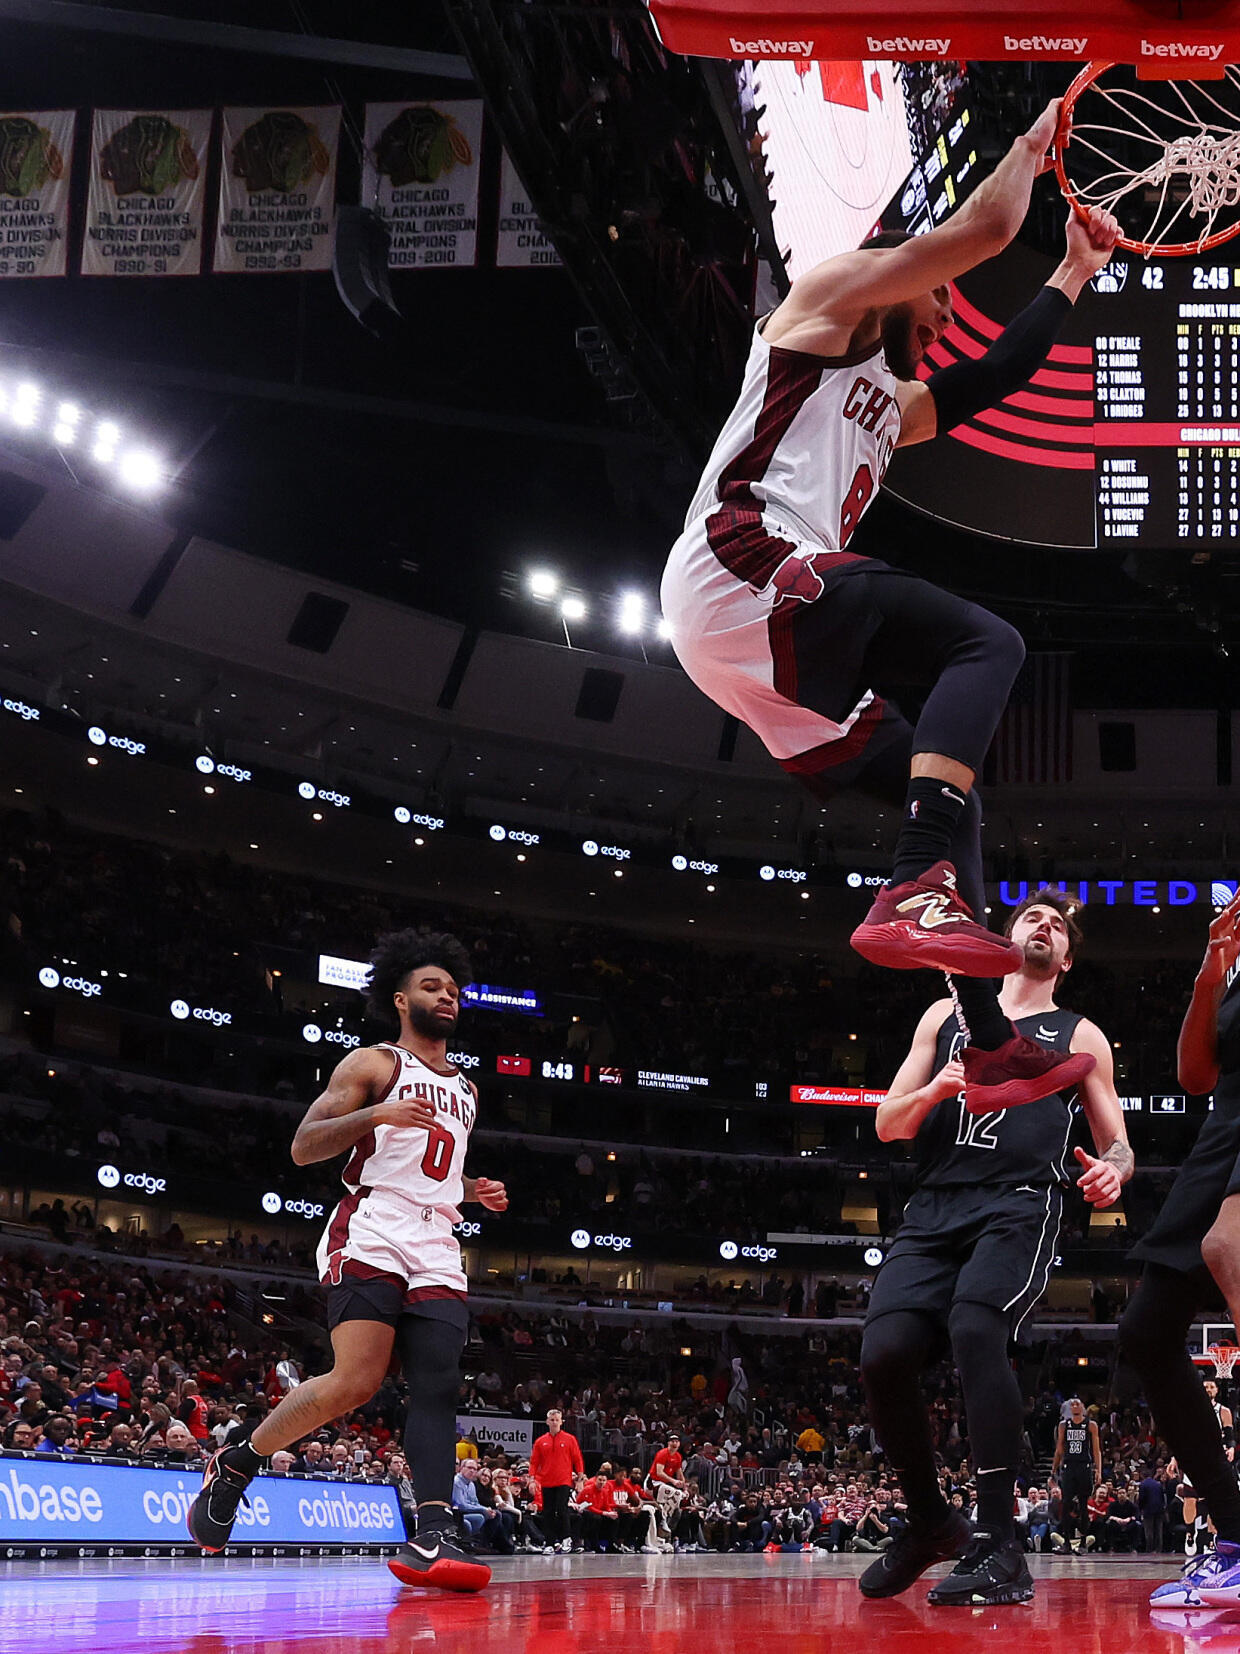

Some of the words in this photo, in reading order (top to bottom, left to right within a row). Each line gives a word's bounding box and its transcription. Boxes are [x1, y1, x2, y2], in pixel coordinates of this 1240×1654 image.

[729, 38, 814, 56] betway
[866, 37, 951, 54] betway
[1004, 36, 1088, 54] betway
[1141, 40, 1224, 60] betway
[392, 190, 449, 203] CHICAGO
[379, 204, 464, 218] LACKHAWKS
[390, 250, 455, 265] 009-2010
[1142, 267, 1163, 289] 42
[1193, 267, 1229, 289] 2:45
[1179, 304, 1228, 317] BROOKLYN
[4, 700, 40, 720] edge
[109, 736, 146, 755] edge
[217, 764, 251, 782] edge
[318, 790, 350, 806] edge
[413, 814, 444, 830] edge
[509, 831, 539, 845] edge
[601, 846, 630, 860] edge
[690, 861, 718, 874] edge
[778, 869, 806, 882] edge
[325, 971, 371, 985] PROGRA
[63, 977, 101, 997] edge
[480, 991, 537, 1008] ASSISTANCE
[193, 1008, 231, 1026] edge
[325, 1031, 361, 1048] edge
[446, 1052, 480, 1069] edge
[543, 1061, 573, 1080] 8:43
[638, 1070, 674, 1083] CLEVELAND
[675, 1073, 709, 1087] CAVALIERS
[798, 1087, 859, 1102] Budweiser
[1160, 1097, 1175, 1111] 42
[955, 1091, 1007, 1149] 12
[420, 1128, 456, 1183] 0
[124, 1173, 166, 1194] edge
[285, 1199, 323, 1219] edge
[595, 1233, 632, 1251] edge
[742, 1245, 777, 1262] edge
[470, 1426, 528, 1443] Advocate
[299, 1489, 395, 1530] coinbase
